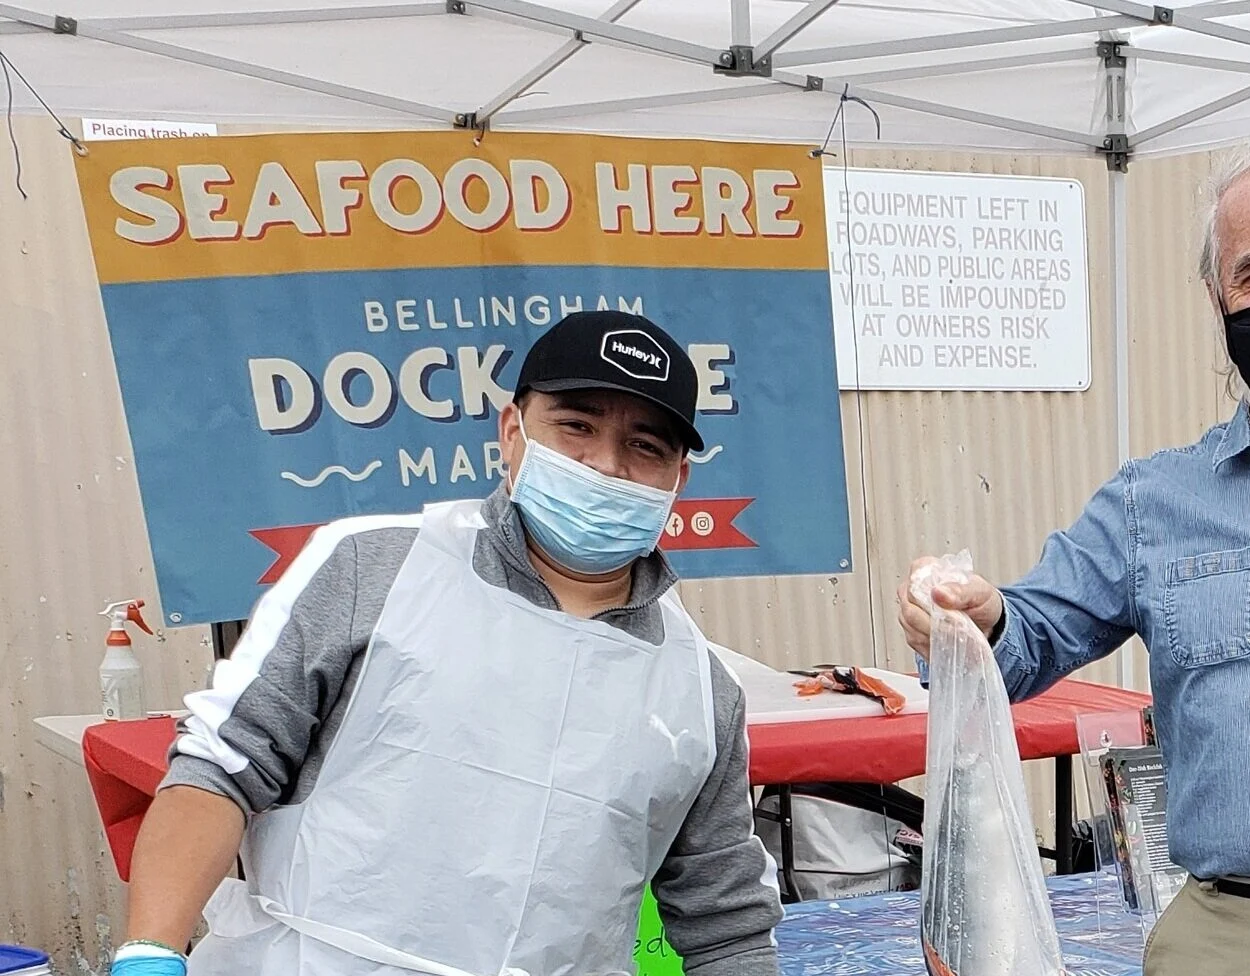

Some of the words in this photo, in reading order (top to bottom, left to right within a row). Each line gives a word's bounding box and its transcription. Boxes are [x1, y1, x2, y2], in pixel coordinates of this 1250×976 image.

[91, 123, 147, 138] Placing
[110, 158, 572, 246] SEAFOOD
[595, 161, 803, 238] HERE
[838, 190, 967, 219] EQUIPMENT
[977, 197, 1029, 221] LEFT
[1039, 199, 1058, 222] IN
[836, 221, 962, 253] ROADWAYS,
[972, 226, 1063, 252] PARKING
[831, 251, 886, 281] LOTS,
[892, 254, 931, 277] AND
[938, 255, 1005, 280] PUBLIC
[1011, 258, 1071, 282] AREAS
[839, 283, 892, 307] WILL
[901, 284, 930, 308] BE
[940, 285, 1066, 310] IMPOUNDED
[364, 295, 644, 332] BELLINGHAM
[861, 314, 886, 337] AT
[896, 314, 990, 338] OWNERS
[1001, 316, 1050, 339] RISK
[612, 341, 650, 362] Hurley
[879, 344, 924, 367] AND
[934, 344, 1037, 368] EXPENSE.
[249, 344, 739, 435] DOCKE
